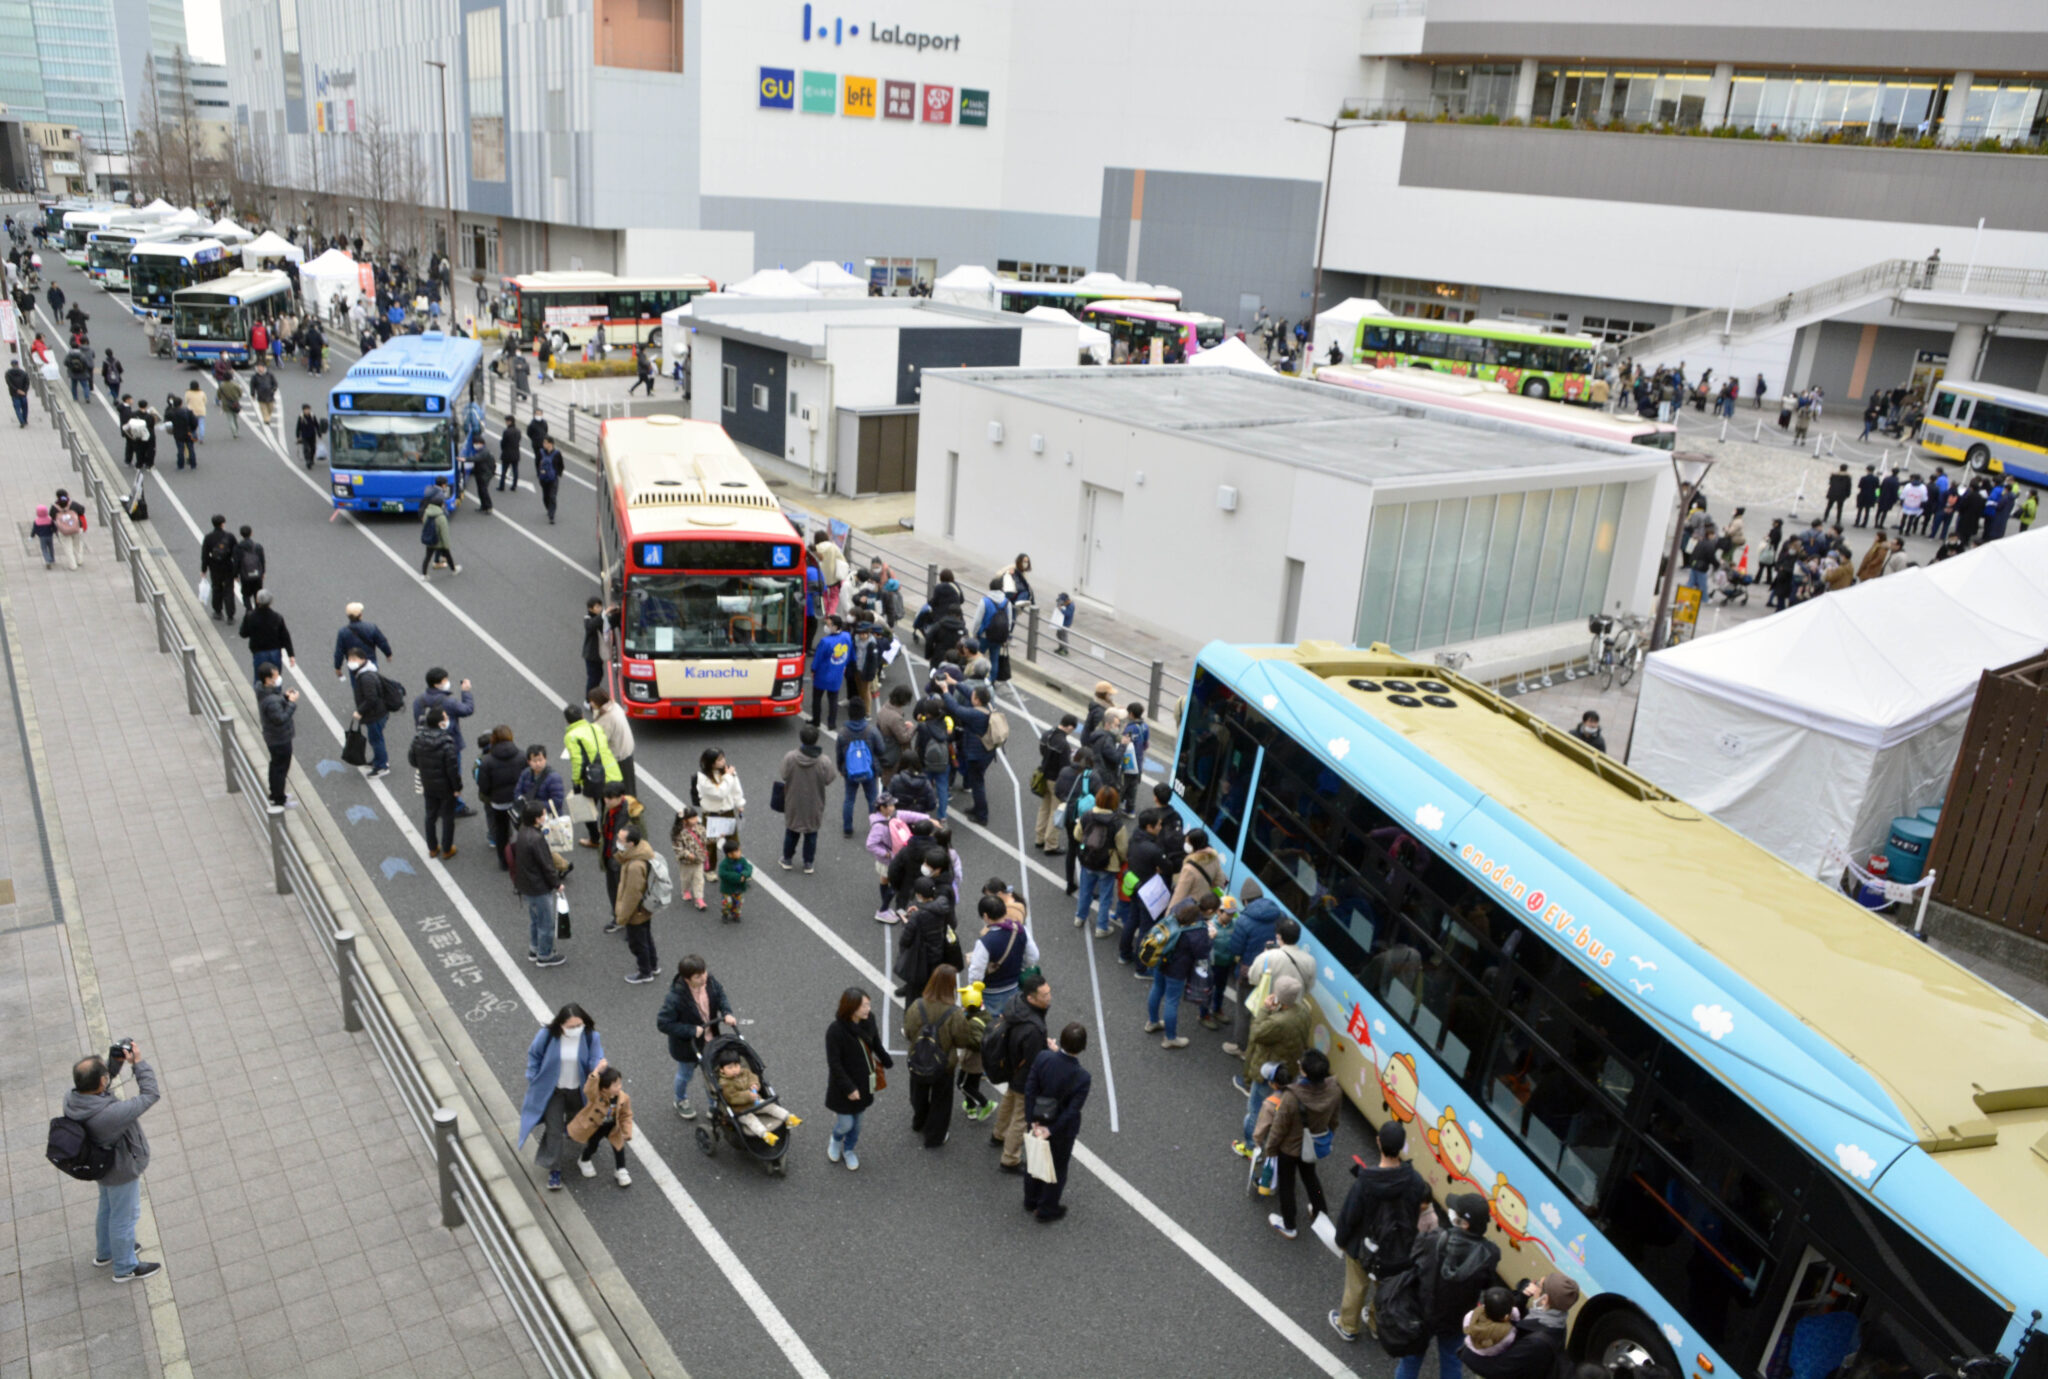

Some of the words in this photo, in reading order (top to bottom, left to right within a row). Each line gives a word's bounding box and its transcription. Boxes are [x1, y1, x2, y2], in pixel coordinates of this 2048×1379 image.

[871, 21, 961, 52] LaLaport
[760, 77, 793, 100] GU
[684, 667, 748, 679] Kanachu
[1461, 844, 1525, 898] enoden
[1541, 905, 1615, 967] EV-bus
[1352, 1014, 1365, 1039] EV
